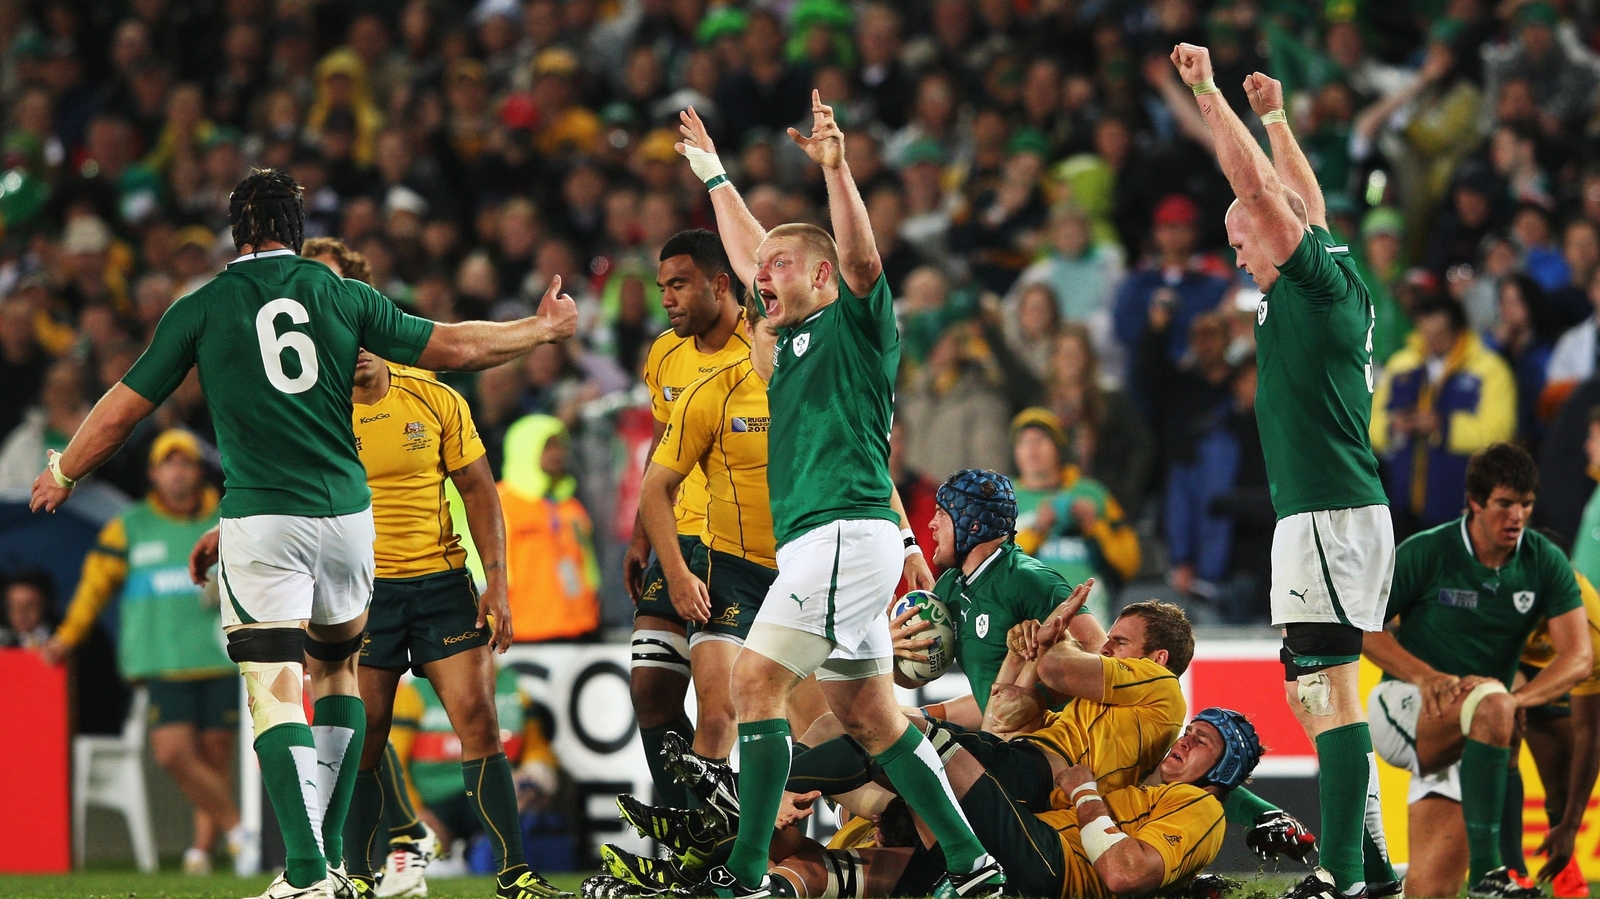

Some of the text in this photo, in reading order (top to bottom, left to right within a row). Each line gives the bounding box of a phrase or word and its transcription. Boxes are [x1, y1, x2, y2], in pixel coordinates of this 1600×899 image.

[256, 298, 318, 394] 6
[360, 413, 390, 424] KooGa
[443, 631, 480, 646] KooGa
